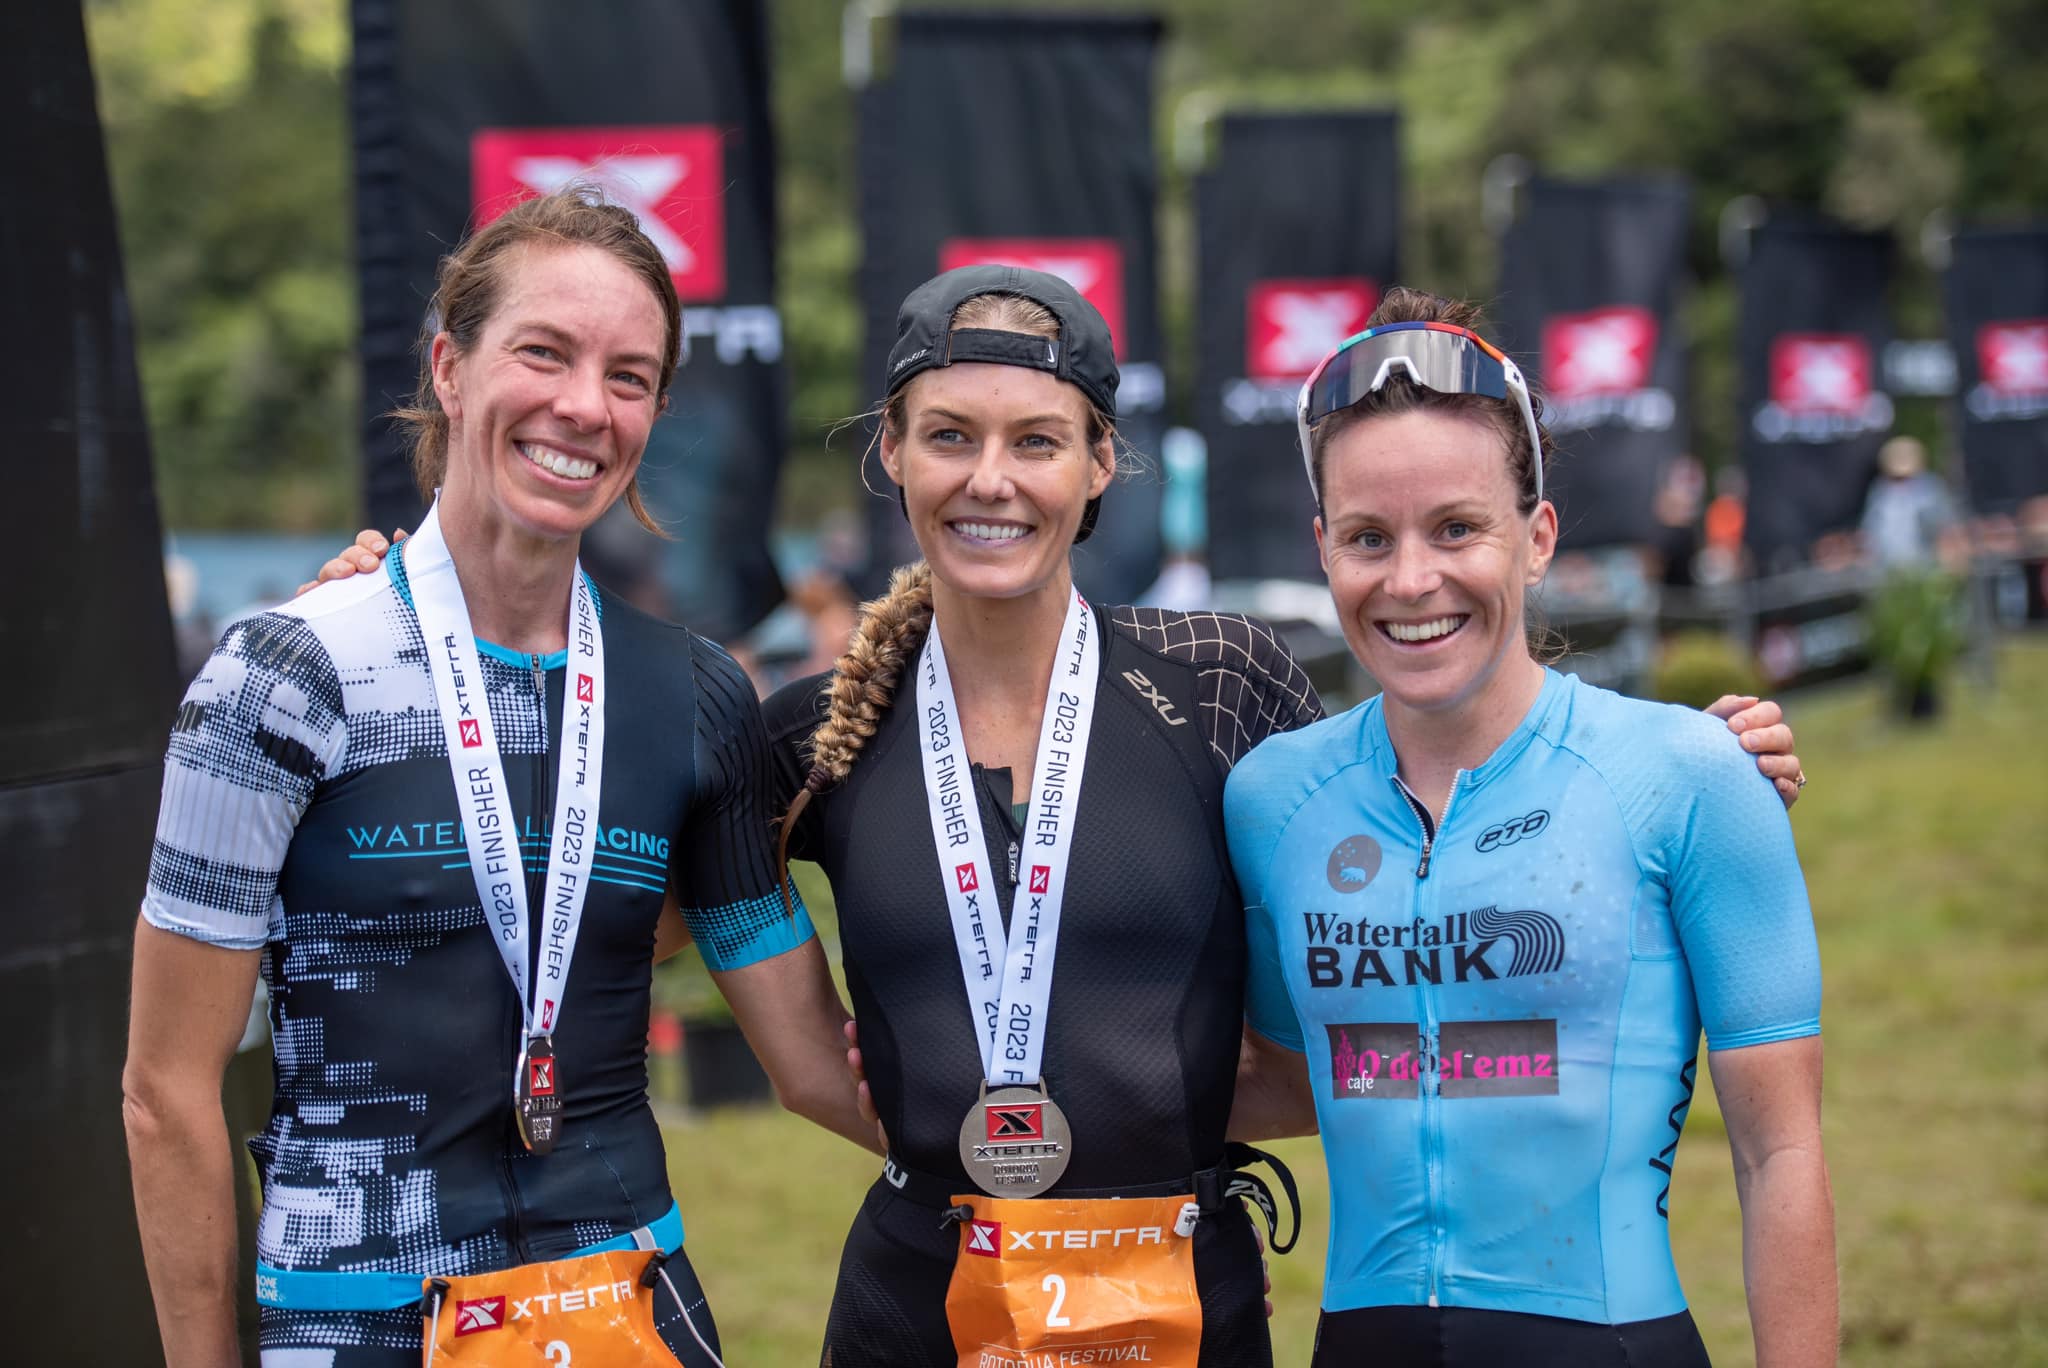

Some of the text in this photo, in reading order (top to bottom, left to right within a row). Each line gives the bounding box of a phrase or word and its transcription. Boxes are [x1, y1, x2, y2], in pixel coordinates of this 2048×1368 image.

[1070, 607, 1088, 676] XTERRA
[445, 634, 472, 717] XTERRA
[1121, 669, 1188, 725] 2XU
[576, 704, 590, 787] XTERRA
[928, 700, 970, 848] 2023 FINISHER
[1035, 691, 1079, 846] 2023 FINISHER
[469, 766, 518, 941] 2023 FINISHER
[546, 806, 586, 980] 2023 FINISHER
[965, 894, 993, 979] XTERRA
[1021, 896, 1042, 981] XTERRA
[1303, 912, 1467, 948] Waterfall
[1307, 940, 1500, 988] BANK
[1005, 1004, 1032, 1061] 2023
[1347, 1070, 1375, 1093] cafe
[1008, 1226, 1162, 1250] XTERRA
[511, 1280, 632, 1321] XTERRA
[1042, 1274, 1071, 1327] 2
[1060, 1345, 1152, 1366] FESTIVAL
